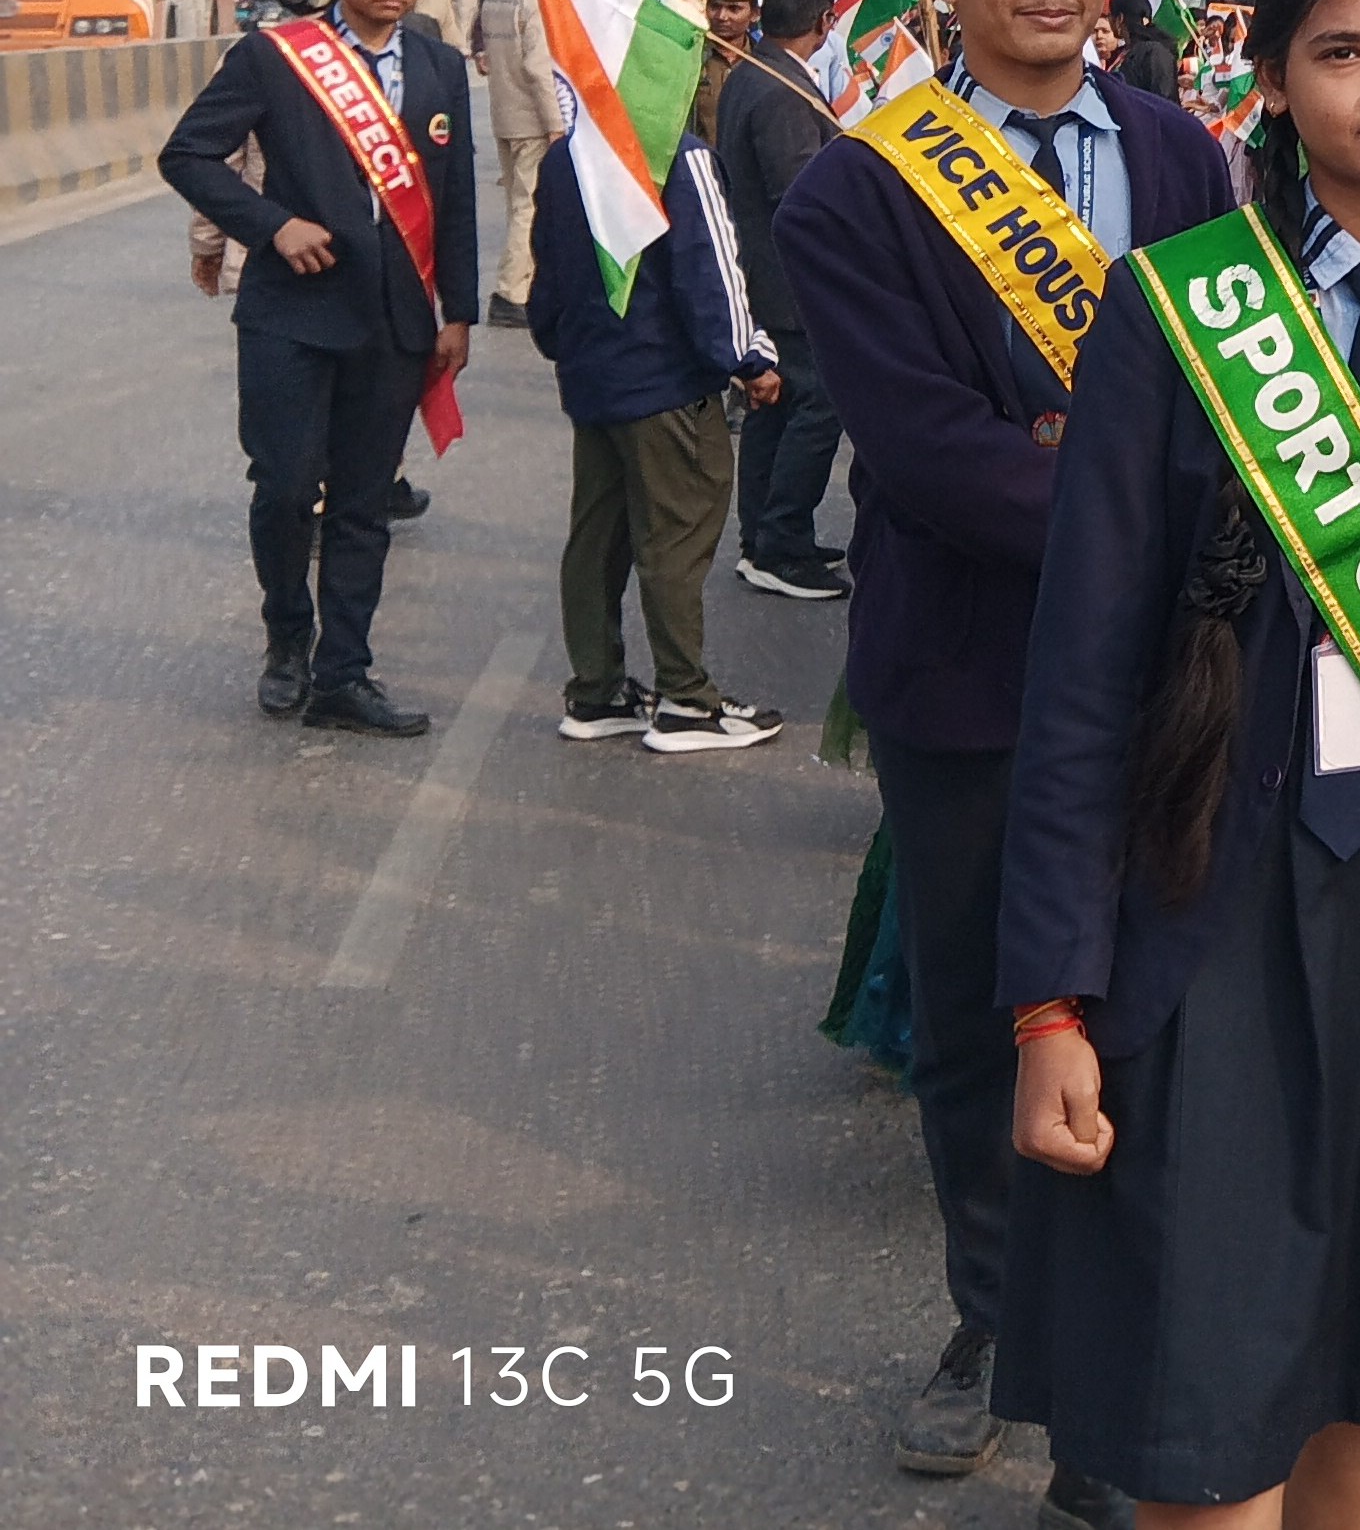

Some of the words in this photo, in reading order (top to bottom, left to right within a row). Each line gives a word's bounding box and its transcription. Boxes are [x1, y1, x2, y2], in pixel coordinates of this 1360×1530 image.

[301, 41, 414, 191] PREFECT
[902, 110, 1010, 212] VICE
[985, 205, 1101, 332] HOUS
